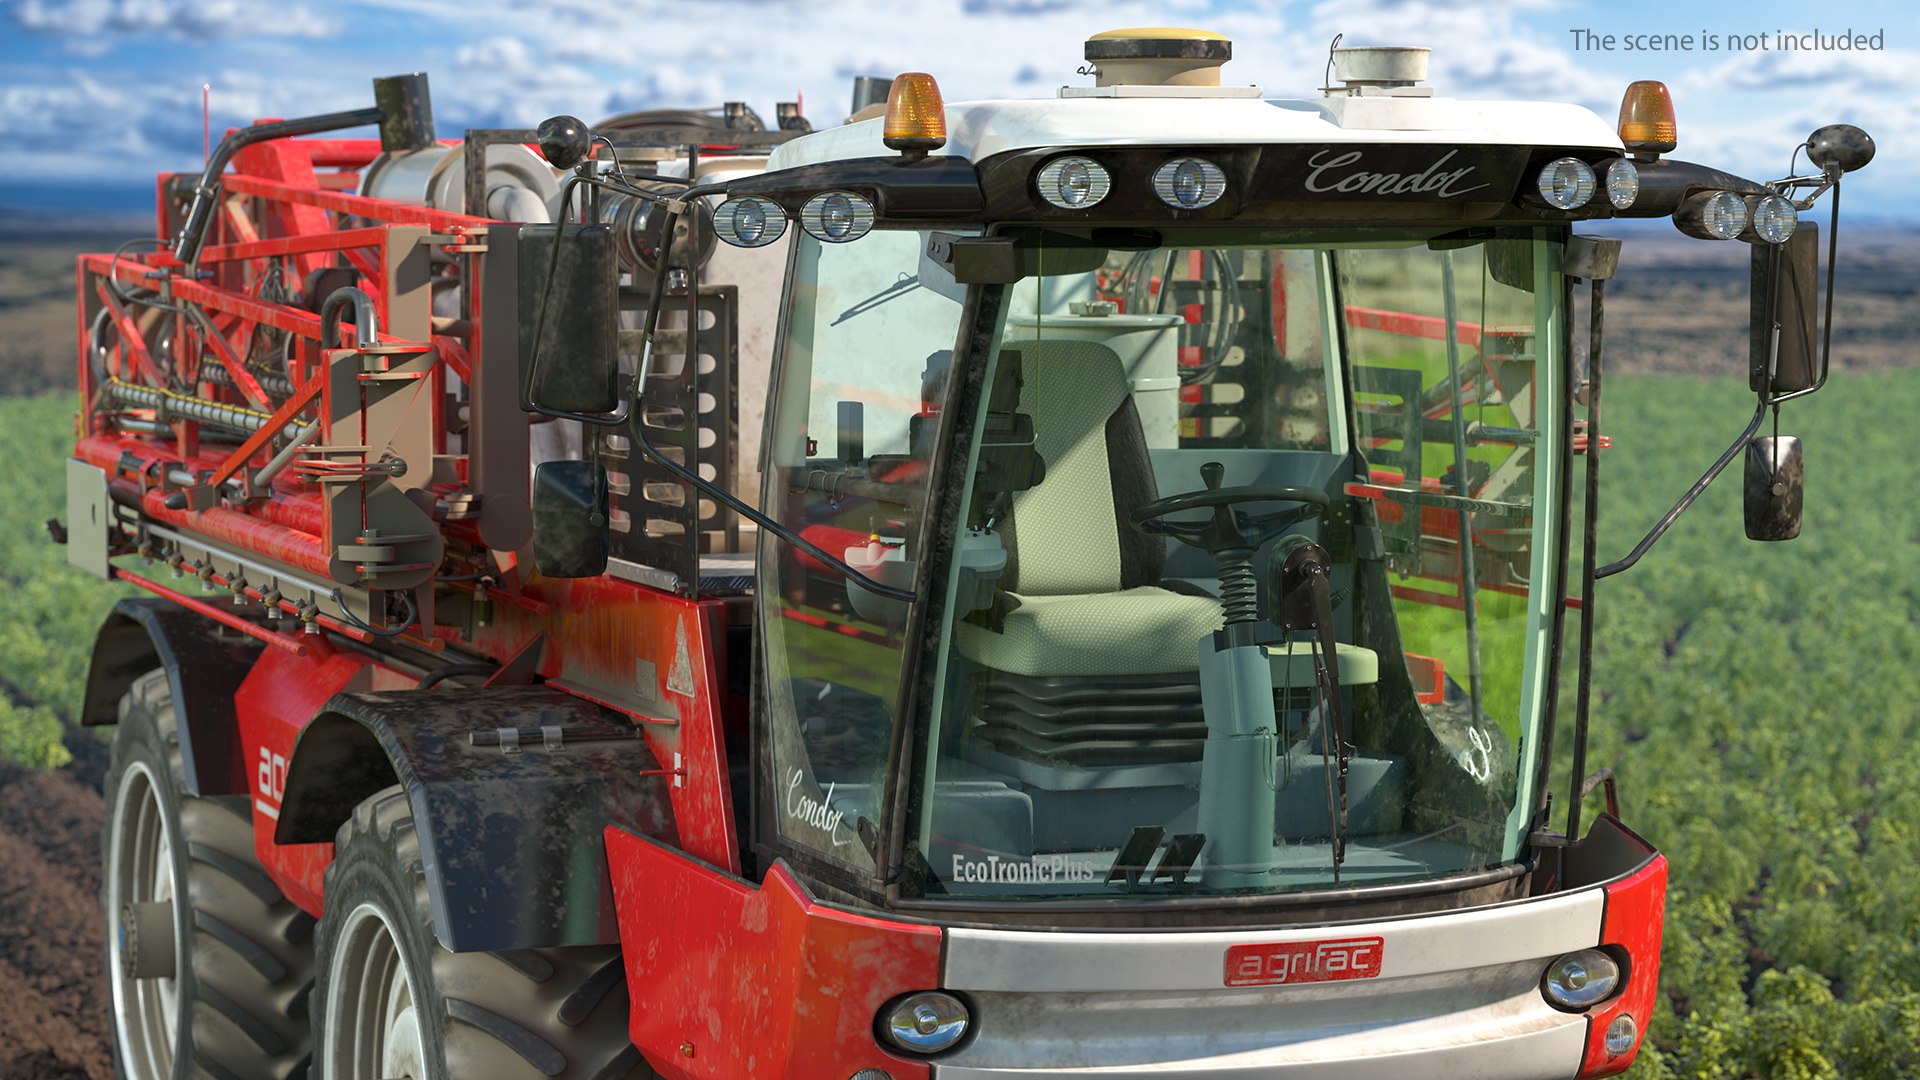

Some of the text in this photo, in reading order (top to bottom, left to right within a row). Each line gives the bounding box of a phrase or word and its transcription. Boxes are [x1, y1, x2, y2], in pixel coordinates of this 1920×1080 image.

[1304, 149, 1490, 198] Condor
[786, 765, 852, 847] Condor
[952, 853, 1095, 883] EcoTronicPlus
[1230, 939, 1380, 985] agrifac
